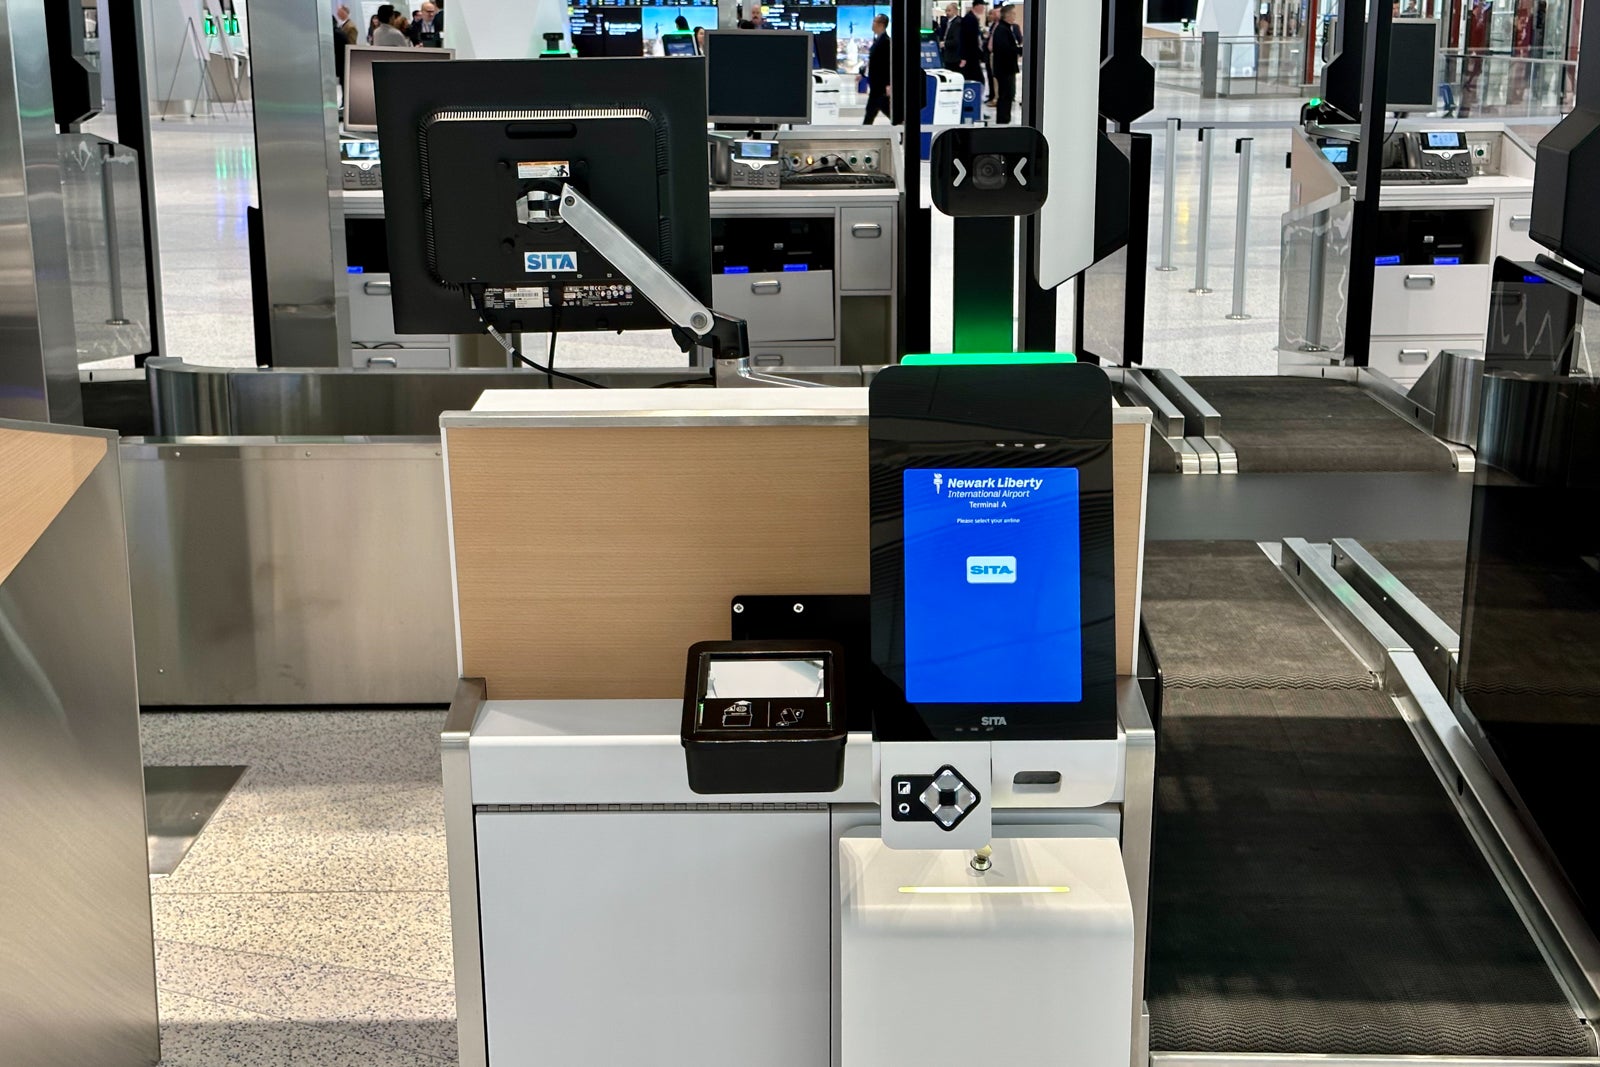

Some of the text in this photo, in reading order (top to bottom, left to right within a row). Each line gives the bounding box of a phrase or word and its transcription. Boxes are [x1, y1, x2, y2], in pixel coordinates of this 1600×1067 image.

[527, 254, 575, 270] SITA
[947, 477, 1042, 489] Newark Liberty
[948, 490, 1030, 499] International Airport
[970, 565, 1013, 575] SITA
[981, 716, 1007, 726] SITA
